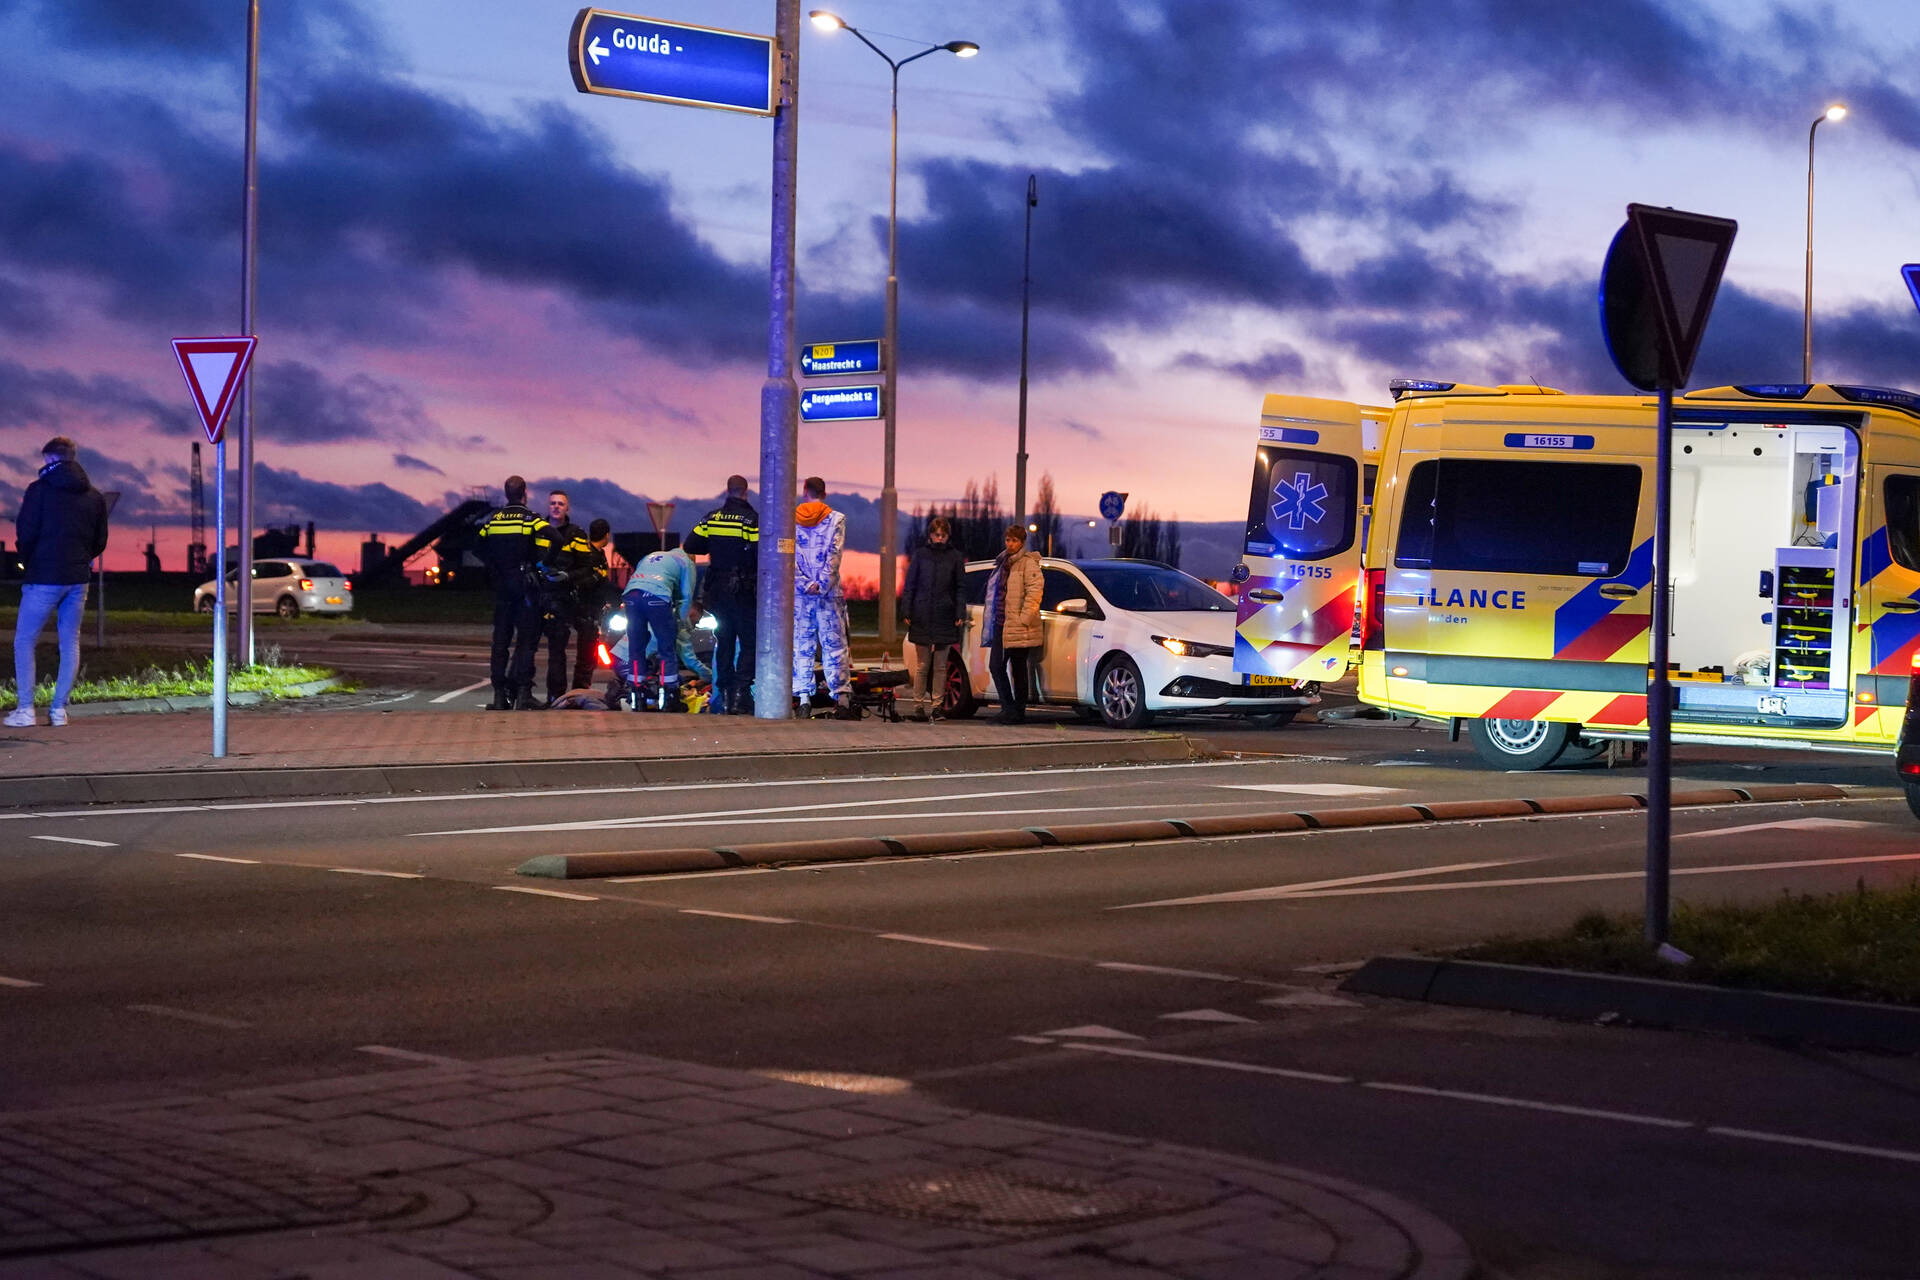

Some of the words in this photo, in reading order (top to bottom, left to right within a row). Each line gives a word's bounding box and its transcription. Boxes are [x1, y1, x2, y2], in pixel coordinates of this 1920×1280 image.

[612, 28, 670, 55] Gouda
[814, 347, 833, 356] N207
[812, 360, 855, 371] Haastrecht
[856, 360, 862, 369] 6
[812, 392, 863, 406] Bergambacht
[864, 392, 873, 401] 12
[1534, 437, 1566, 446] 16155
[1289, 564, 1332, 579] 16155
